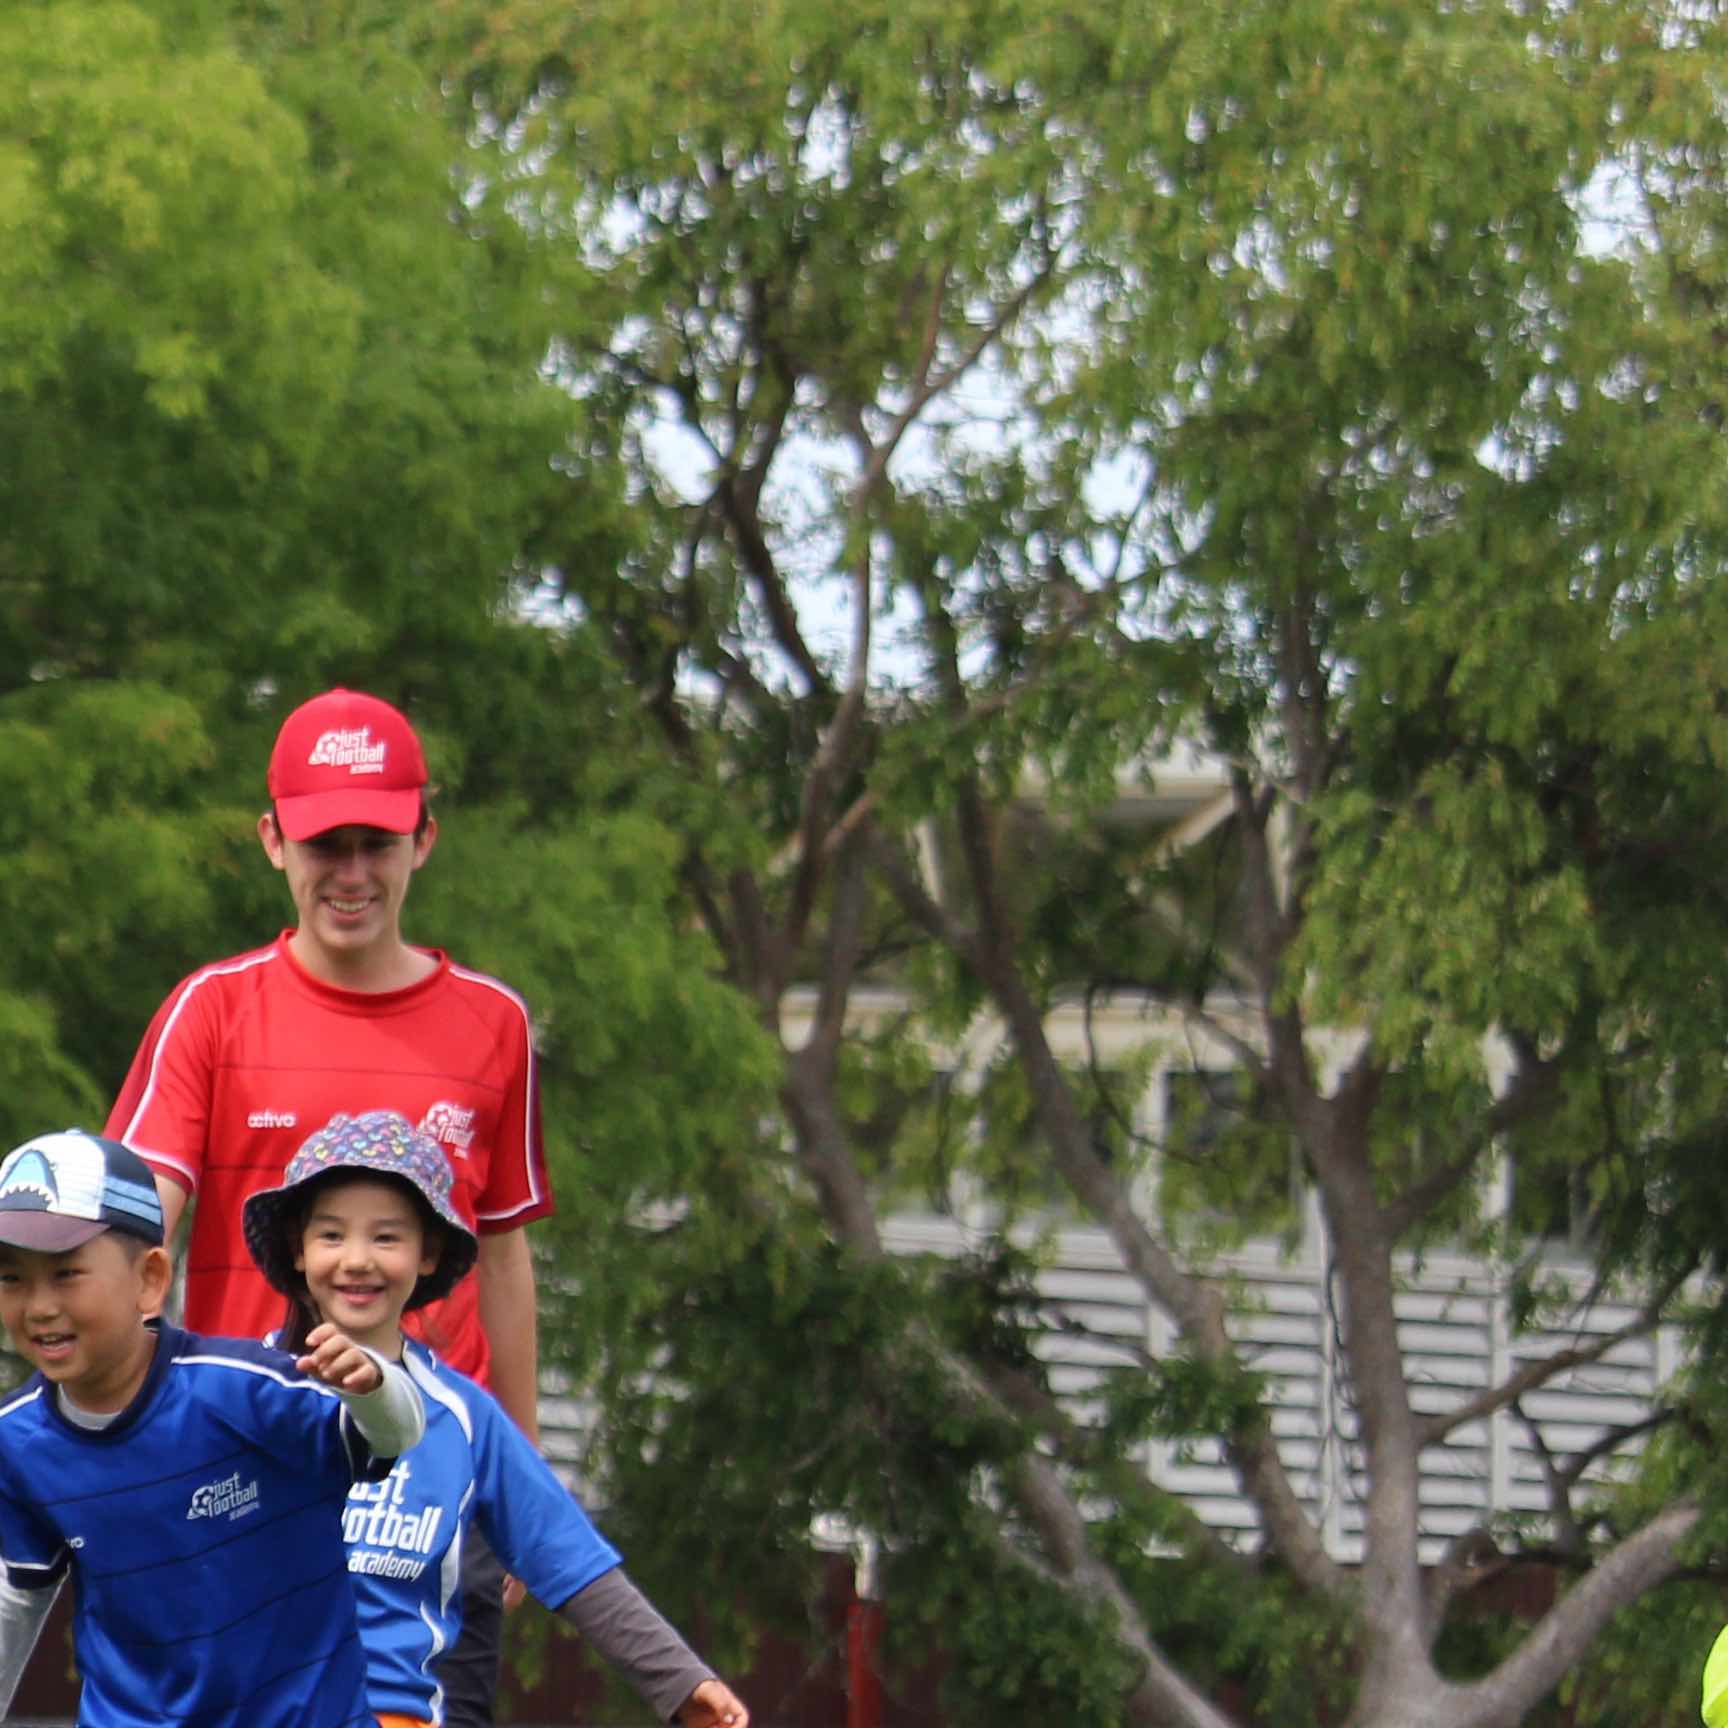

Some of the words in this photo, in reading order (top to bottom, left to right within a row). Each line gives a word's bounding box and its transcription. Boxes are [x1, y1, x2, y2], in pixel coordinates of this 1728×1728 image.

[208, 1480, 258, 1518] football
[213, 1471, 240, 1501] just
[341, 1501, 443, 1554] otball
[347, 1549, 426, 1583] academy
